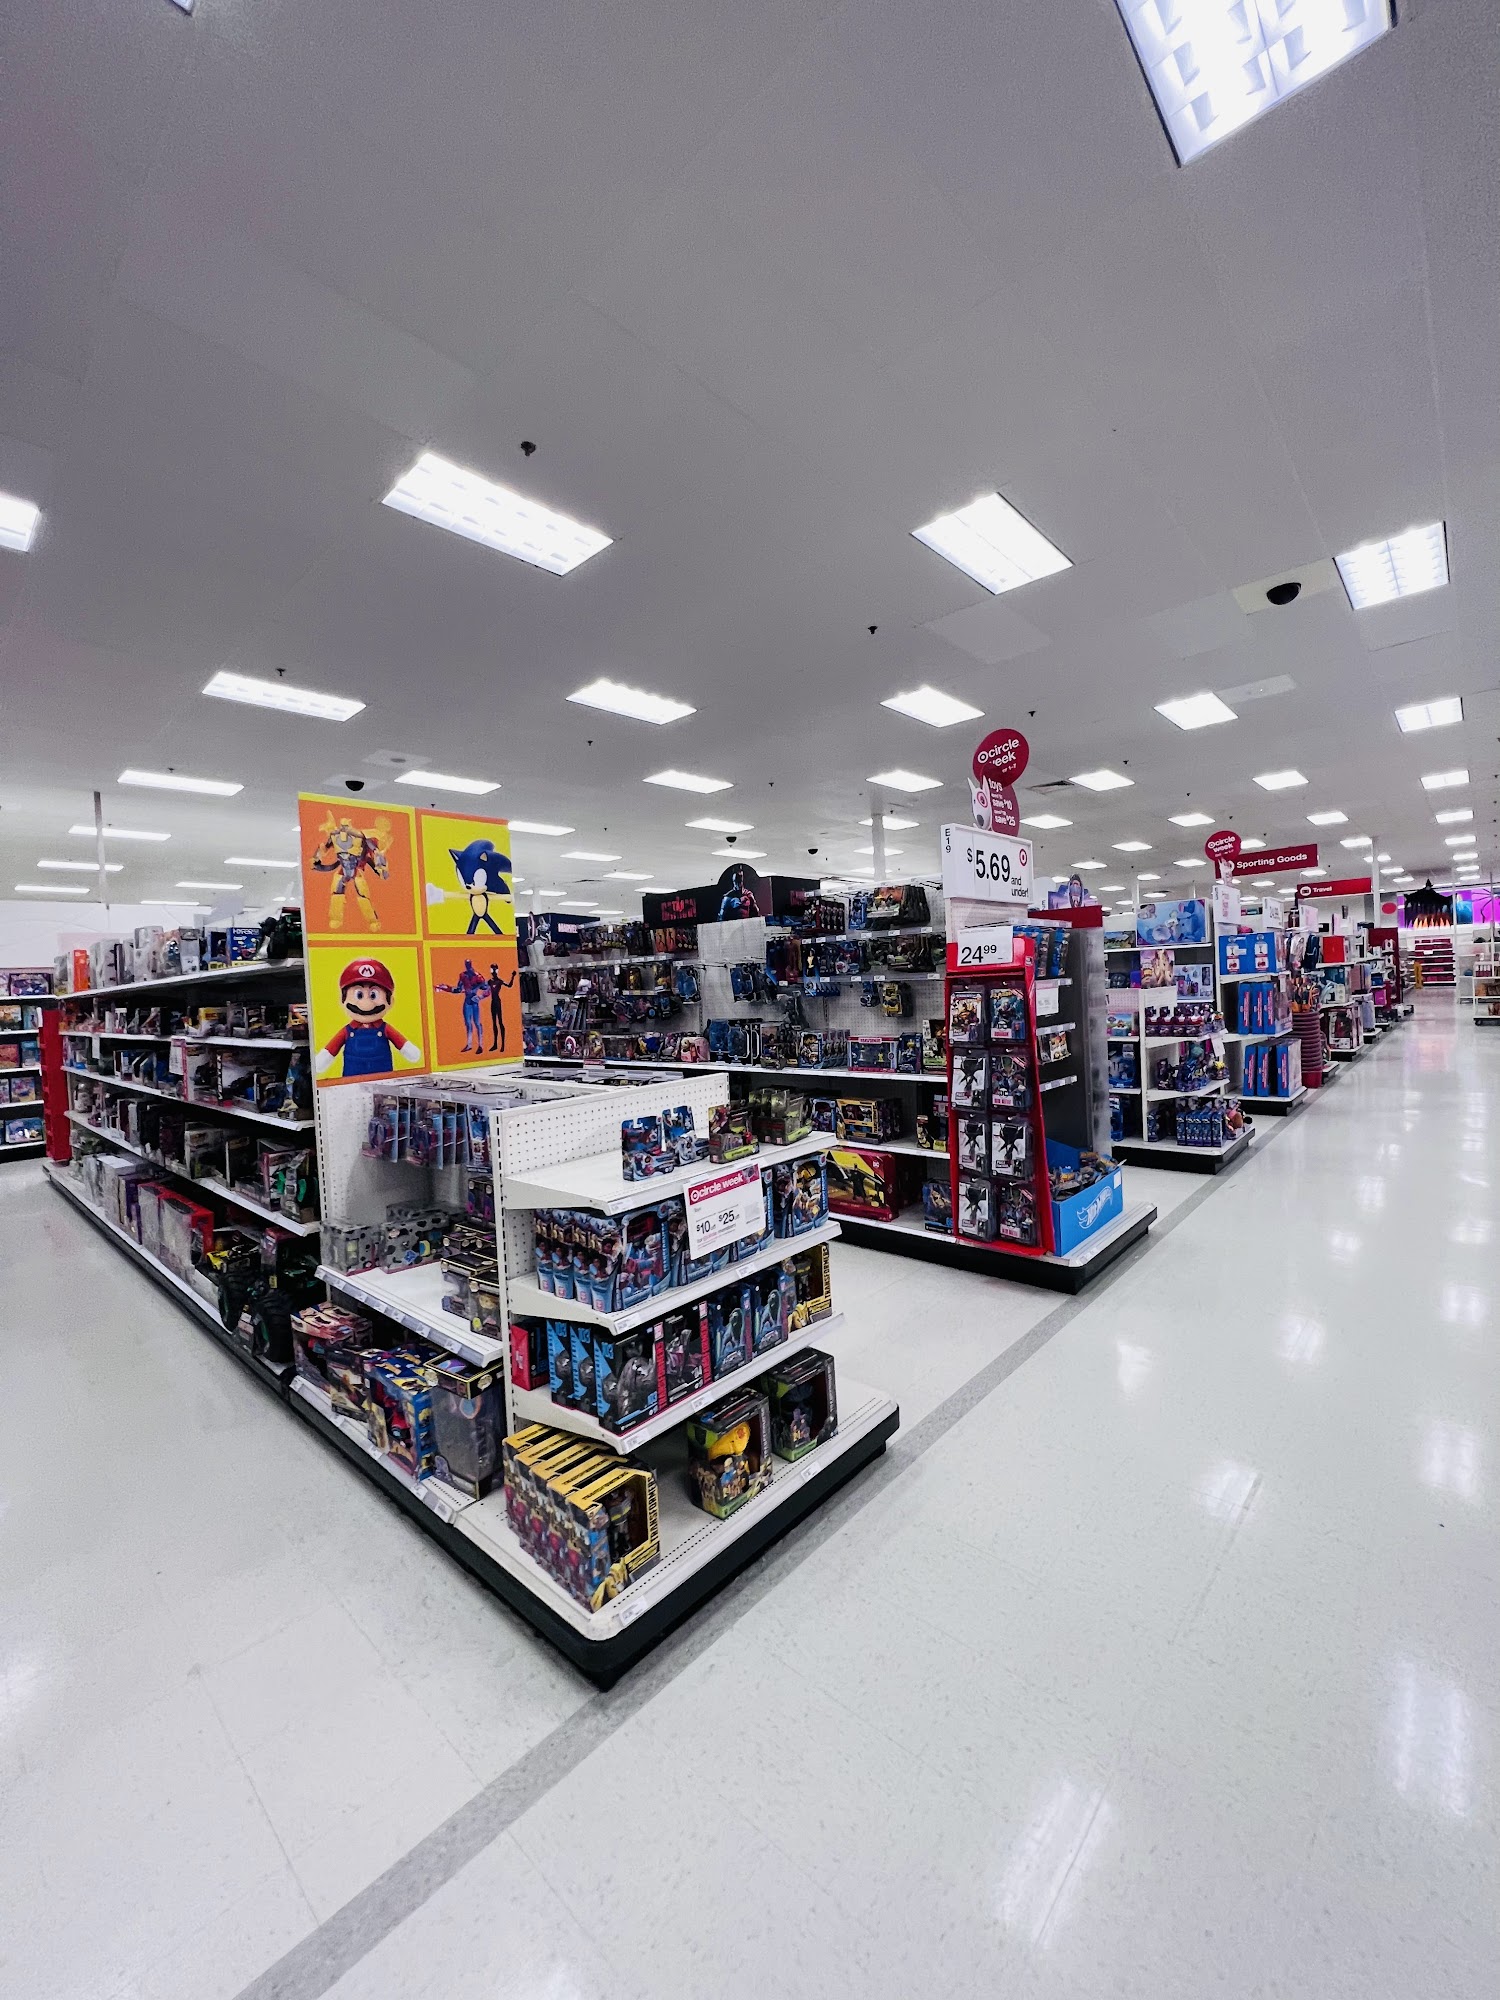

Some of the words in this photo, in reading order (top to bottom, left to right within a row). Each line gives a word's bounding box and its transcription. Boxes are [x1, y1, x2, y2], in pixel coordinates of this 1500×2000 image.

[988, 738, 1020, 759] circle
[988, 751, 1017, 767] eek
[988, 778, 1003, 792] toys
[1236, 857, 1275, 870] Sporting
[1277, 852, 1308, 864] Goods
[1011, 877, 1022, 886] and
[1011, 887, 1029, 898] under!
[700, 1182, 722, 1198] circle
[722, 1173, 744, 1189] week
[696, 1220, 711, 1234] $10
[718, 1210, 735, 1225] $25
[824, 1247, 832, 1299] TRANSFORMERS
[647, 1477, 659, 1543] TRANSFORMERS
